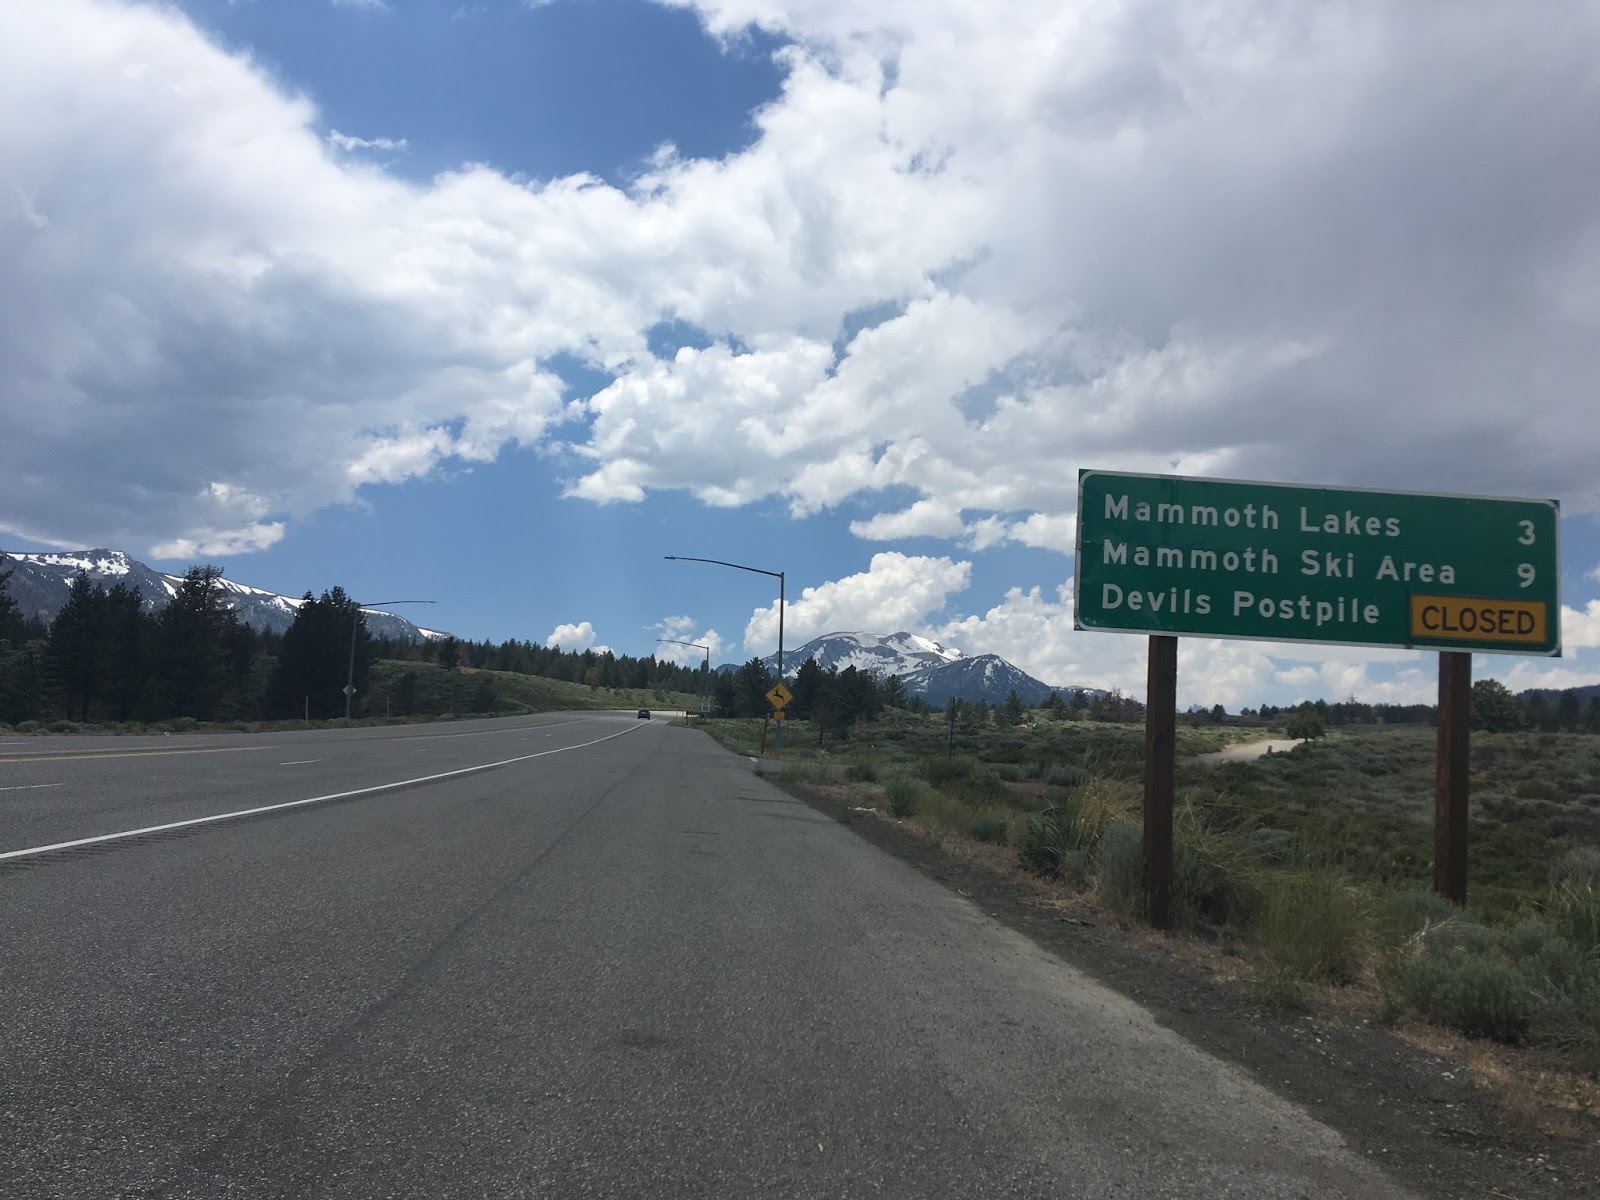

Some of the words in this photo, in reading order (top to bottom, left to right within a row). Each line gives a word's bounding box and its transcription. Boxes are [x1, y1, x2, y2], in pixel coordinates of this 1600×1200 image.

[1104, 493, 1280, 530] Mammoth
[1300, 506, 1401, 537] Lakes
[1517, 519, 1537, 546] 3
[1103, 538, 1279, 574] Mammoth
[1301, 549, 1354, 579] Ski
[1375, 555, 1456, 585] Area
[1516, 563, 1537, 588] 9
[1101, 583, 1212, 615] Devils
[1233, 591, 1380, 626] Postpile
[1421, 605, 1535, 634] CLOSED
